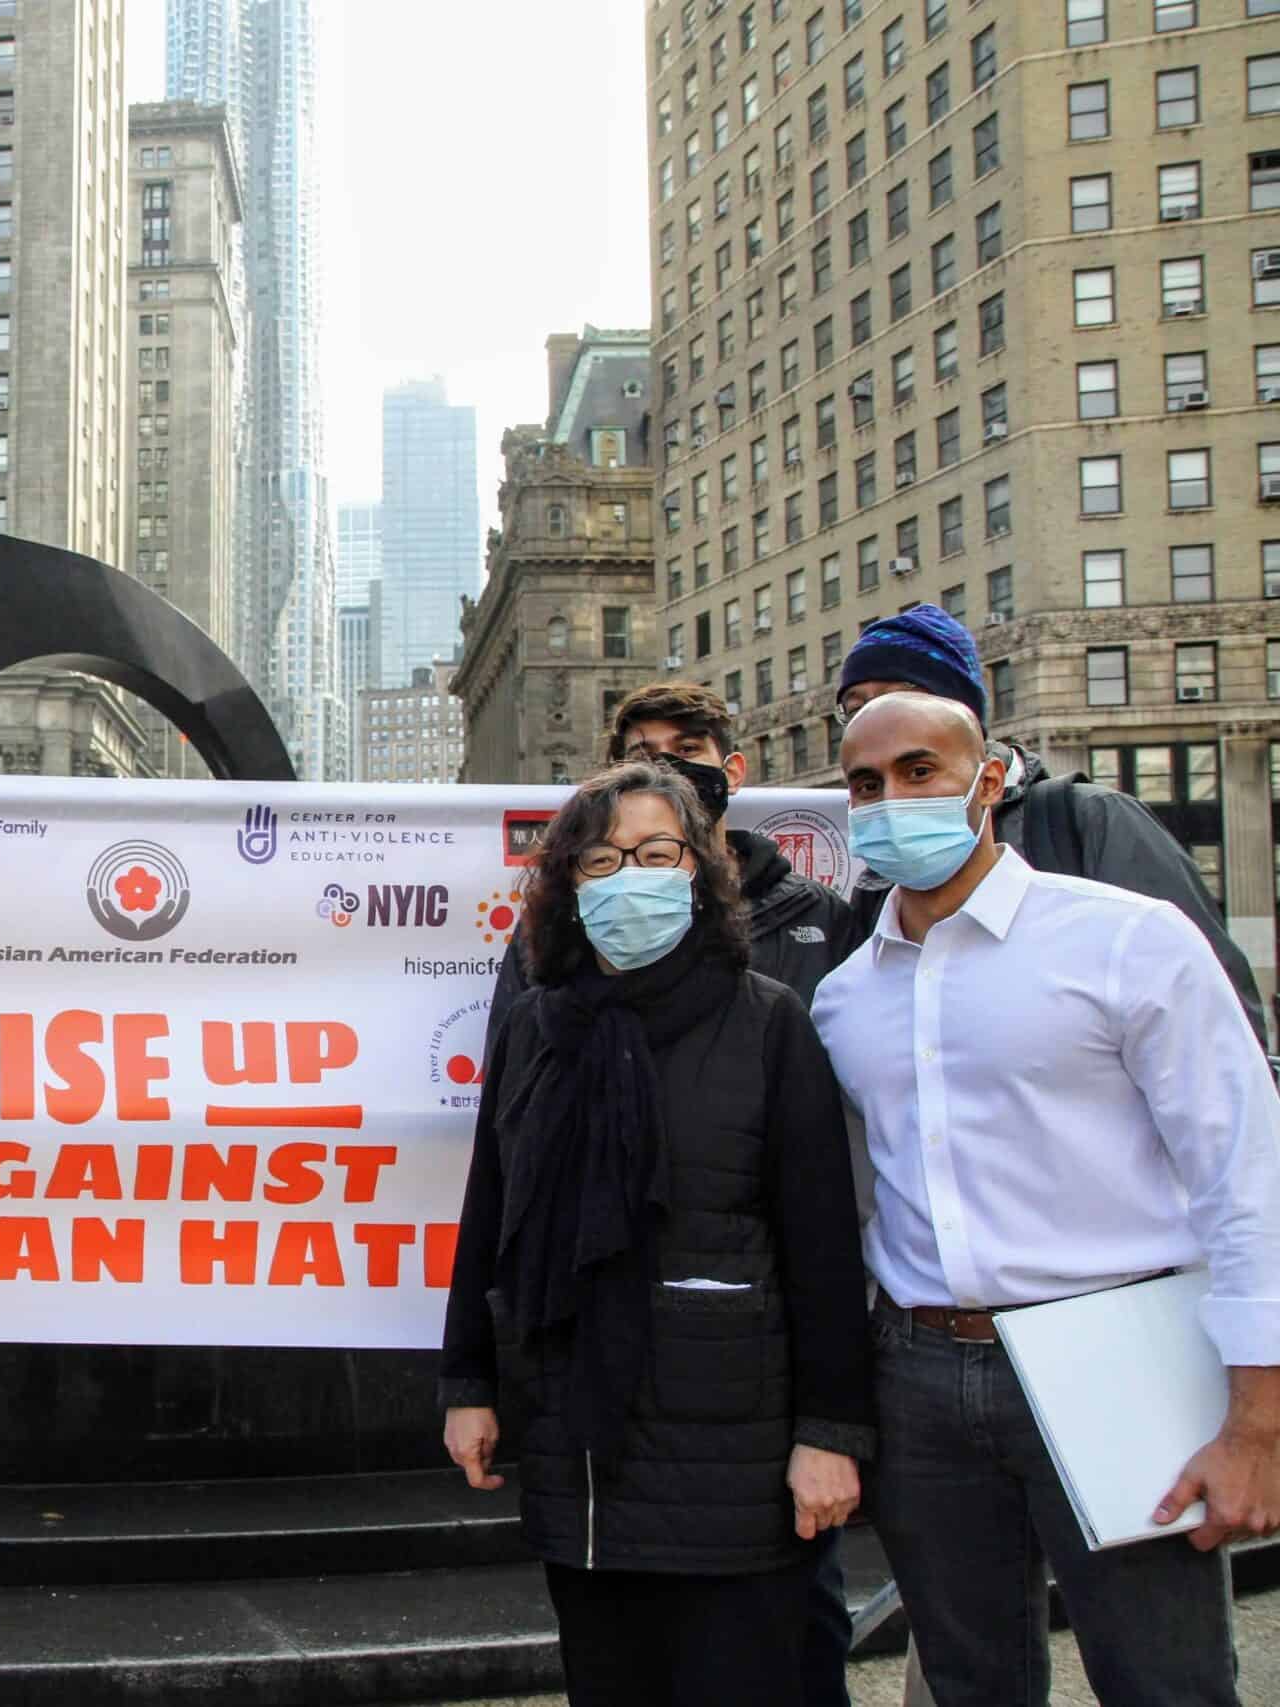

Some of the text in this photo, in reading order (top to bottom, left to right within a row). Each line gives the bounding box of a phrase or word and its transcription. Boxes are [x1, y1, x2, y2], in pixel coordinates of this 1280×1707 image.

[290, 812, 397, 824] CENTER FOR
[290, 831, 456, 844] ANTI-VIOLENCE
[290, 852, 385, 862] EDUCATION
[367, 884, 449, 927] NYIC
[47, 946, 163, 964] American
[169, 948, 298, 965] Federation
[404, 957, 504, 979] hispanicfe
[431, 1053, 441, 1083] Over
